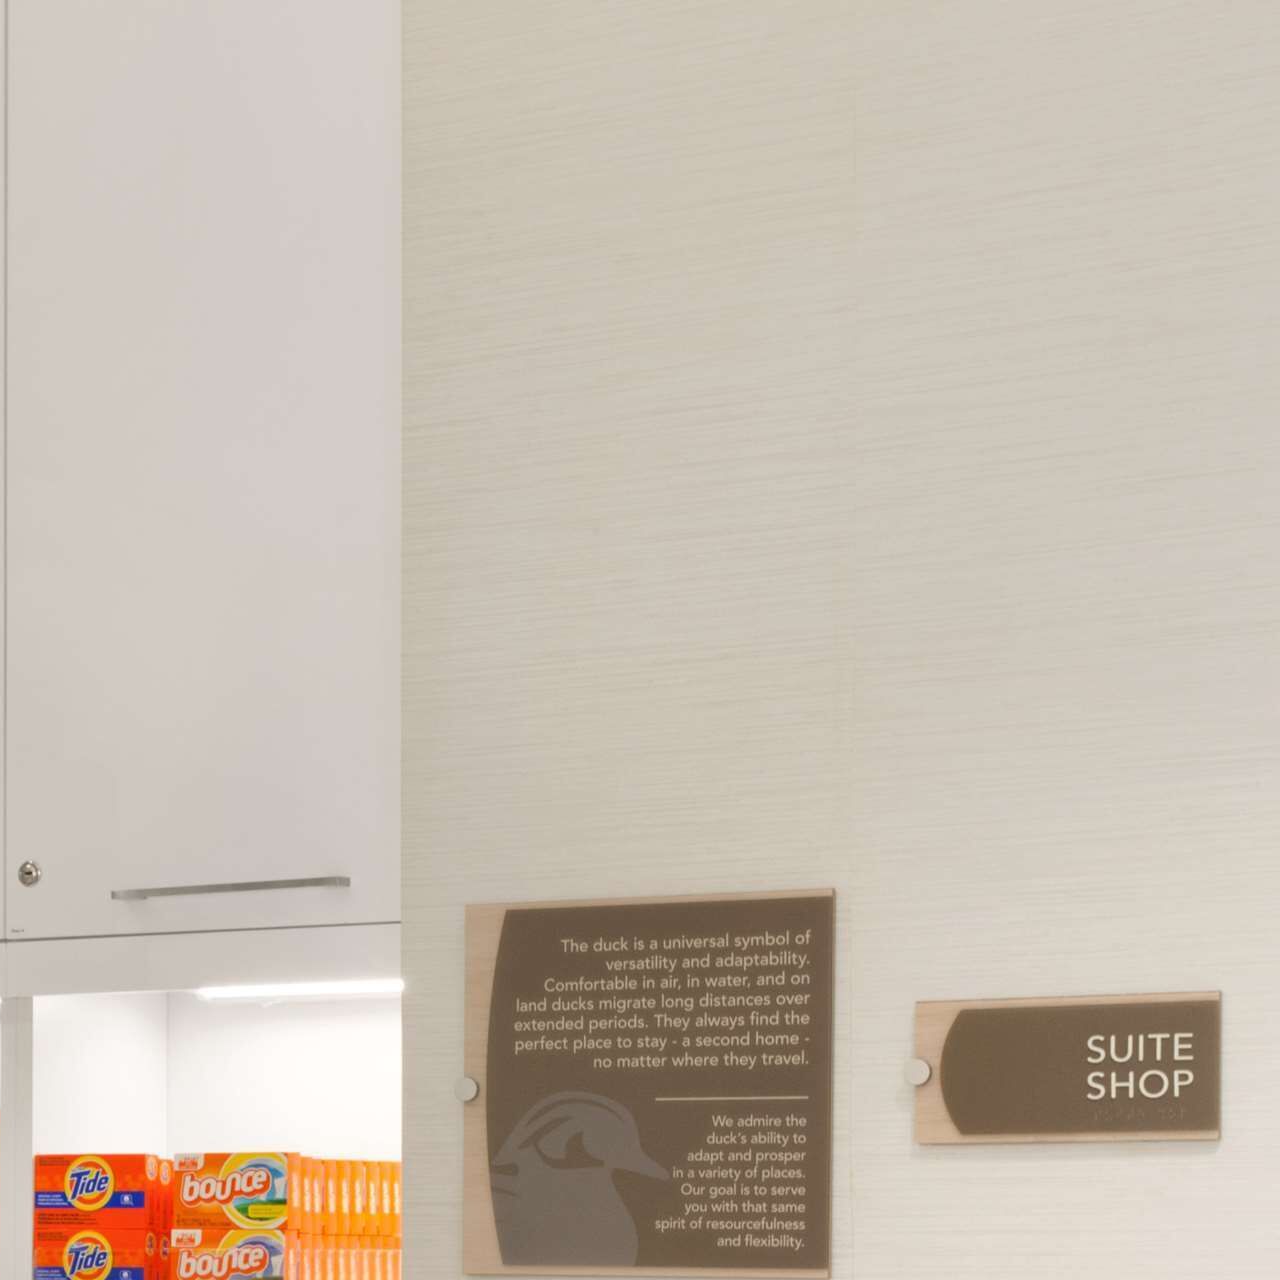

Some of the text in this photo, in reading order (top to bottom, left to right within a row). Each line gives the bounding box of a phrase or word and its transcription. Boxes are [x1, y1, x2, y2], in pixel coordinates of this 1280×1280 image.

[560, 929, 811, 953] The duck is a universal symbol of
[606, 950, 810, 973] versatility and adaptability.
[544, 970, 810, 992] Comfortable in air, in water, and on
[516, 992, 810, 1013] land ducks migrate long distances over
[514, 1010, 810, 1034] extended periods. They always find the
[514, 1031, 800, 1055] perfect place to stay a second home
[1087, 1033, 1194, 1063] SUITE
[593, 1050, 809, 1070] no matter where they travel.
[1087, 1070, 1194, 1100] SHOP
[711, 1114, 807, 1128] We admire the
[750, 1131, 789, 1148] ability
[792, 1133, 807, 1144] to
[687, 1148, 806, 1165] adapt and prosper
[69, 1166, 110, 1201] Tide
[672, 1165, 806, 1182] in a variety of places.
[182, 1168, 268, 1203] bounce
[680, 1182, 806, 1199] Our goal is to serve
[684, 1200, 806, 1216] you with that same
[655, 1216, 806, 1233] spirit of resourcefulness
[716, 1234, 805, 1251] and flexibility.
[68, 1245, 108, 1278] Tide
[178, 1247, 265, 1279] bounce
